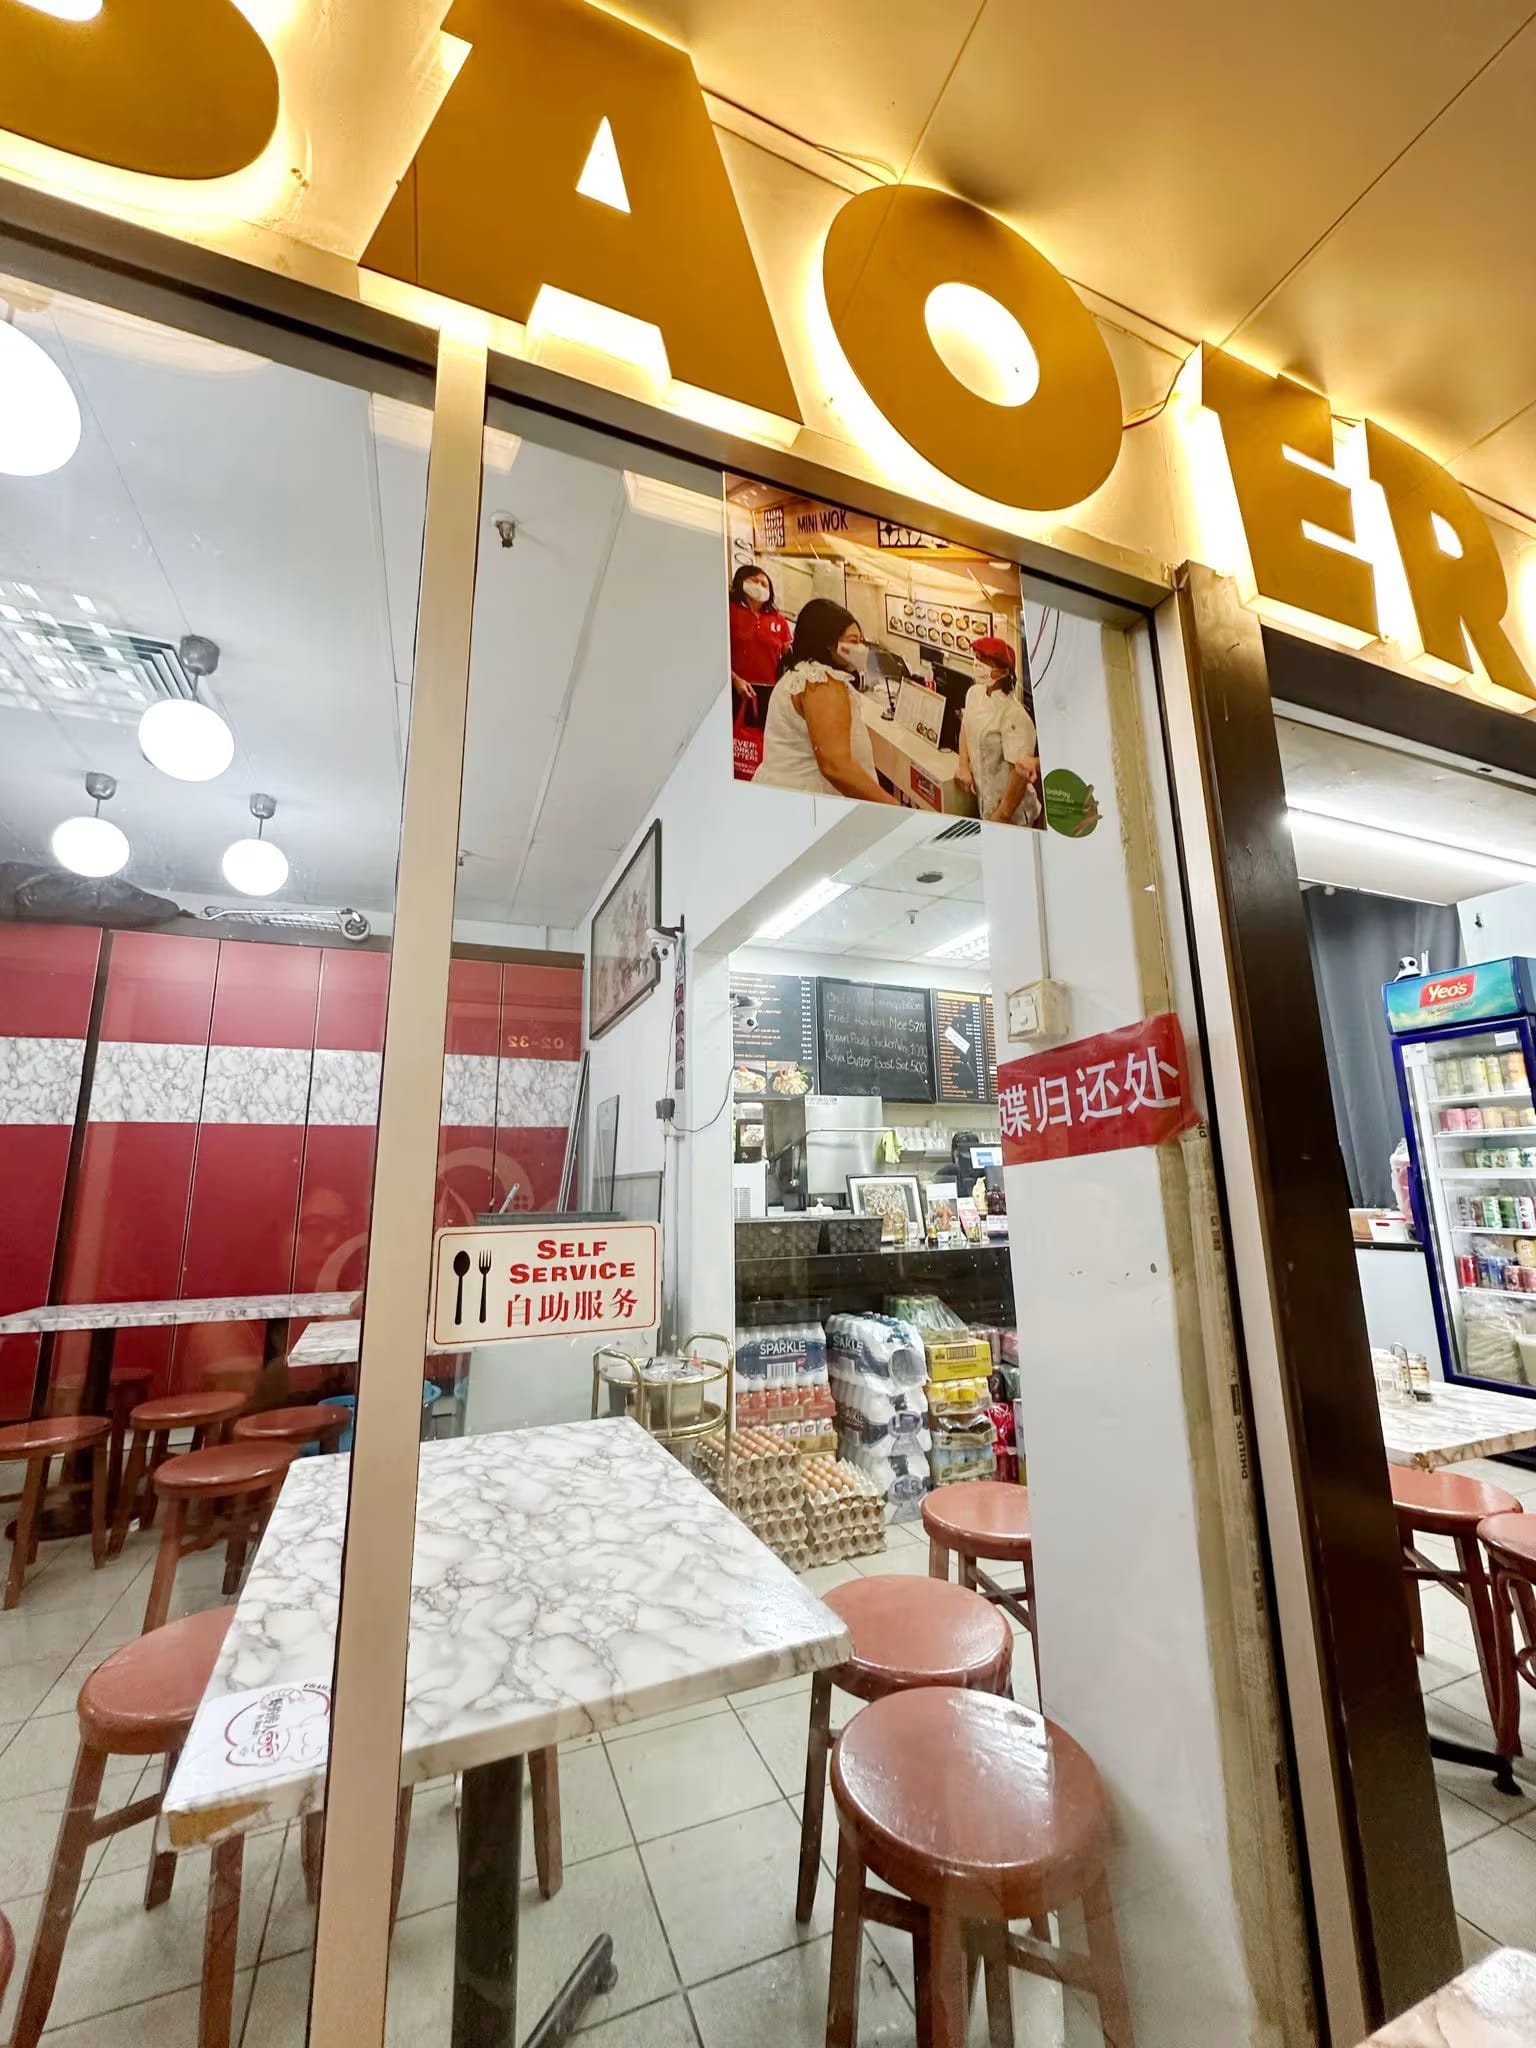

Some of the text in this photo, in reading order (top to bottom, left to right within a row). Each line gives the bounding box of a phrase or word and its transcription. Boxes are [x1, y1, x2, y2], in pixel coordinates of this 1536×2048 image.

[797, 509, 848, 533] MINI WOK
[1428, 982, 1468, 1002] Yeo's
[998, 1046, 1181, 1138] 碟归还处
[537, 1239, 608, 1260] SELF
[509, 1261, 636, 1285] SERVICE
[507, 1287, 639, 1328] 自助服务
[759, 1340, 806, 1355] SPARKLE
